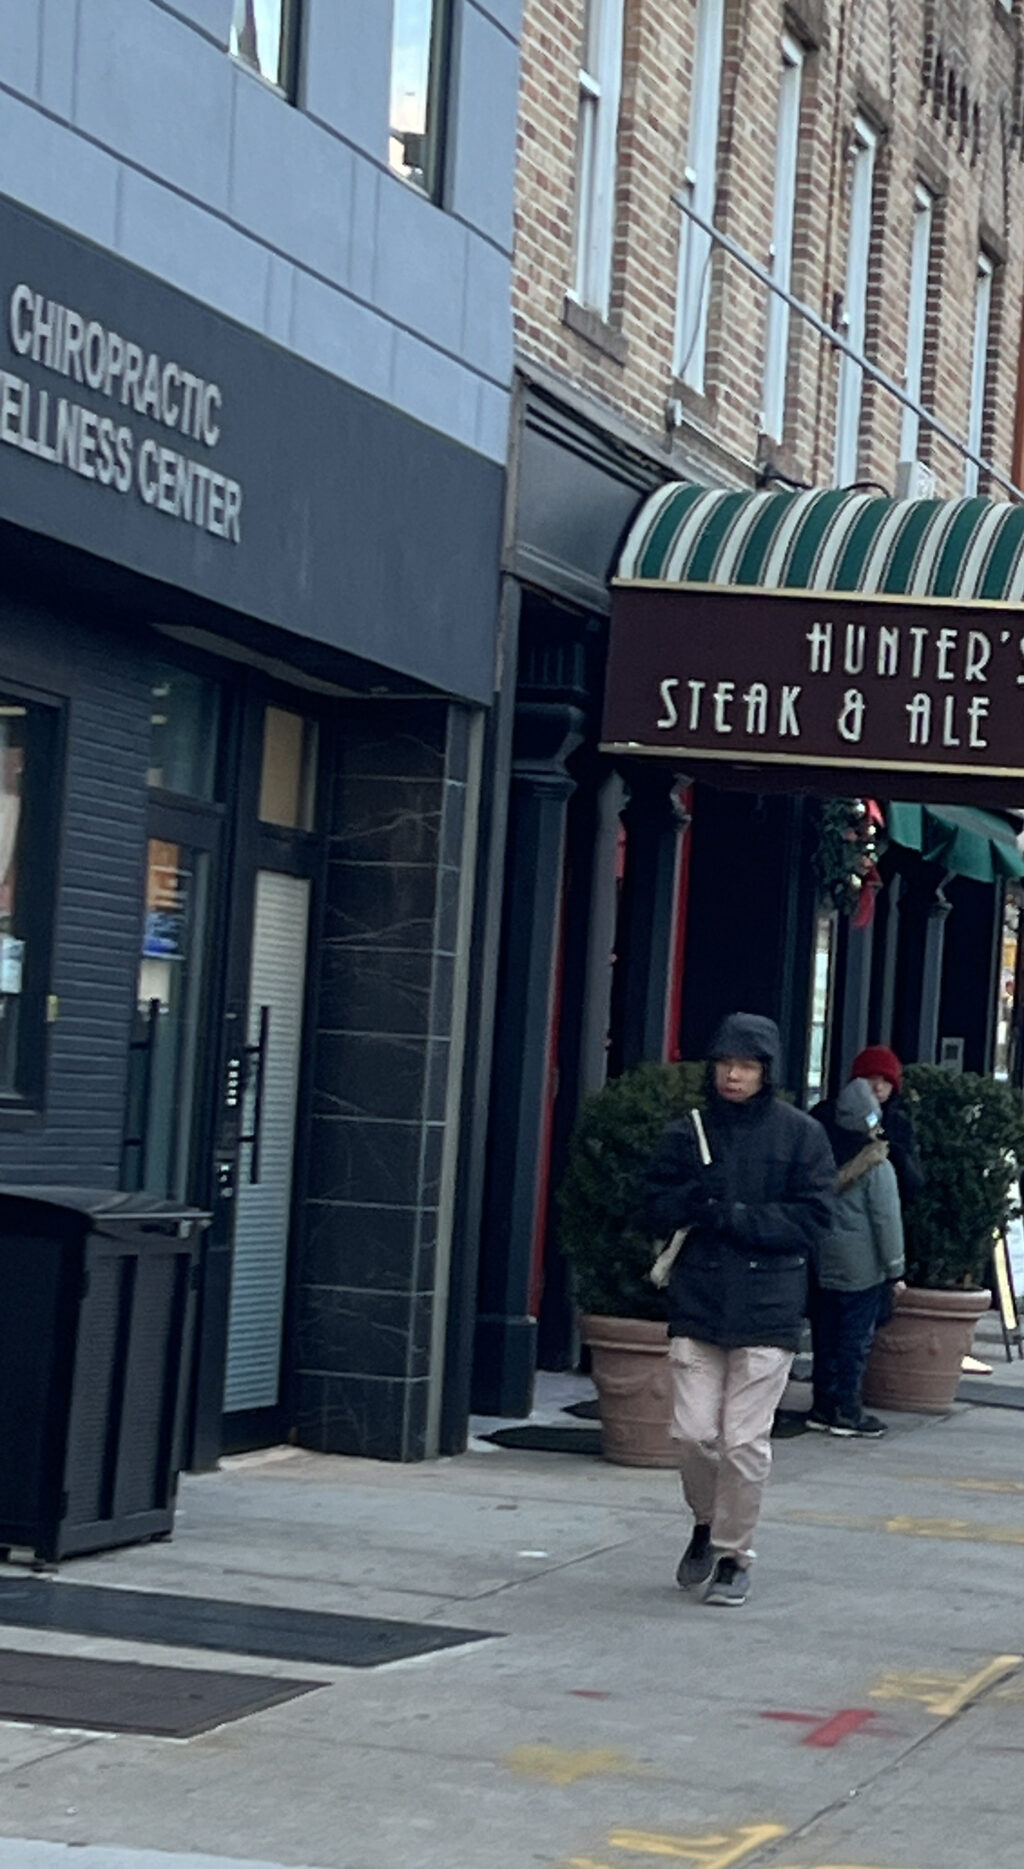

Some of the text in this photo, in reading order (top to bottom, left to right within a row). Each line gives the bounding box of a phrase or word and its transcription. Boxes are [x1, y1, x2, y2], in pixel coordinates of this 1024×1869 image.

[10, 283, 222, 447] CHIROPRACTIC
[138, 439, 242, 543] CENTER
[656, 678, 802, 736] STEAK
[837, 688, 866, 742] &
[905, 692, 990, 748] ALE
